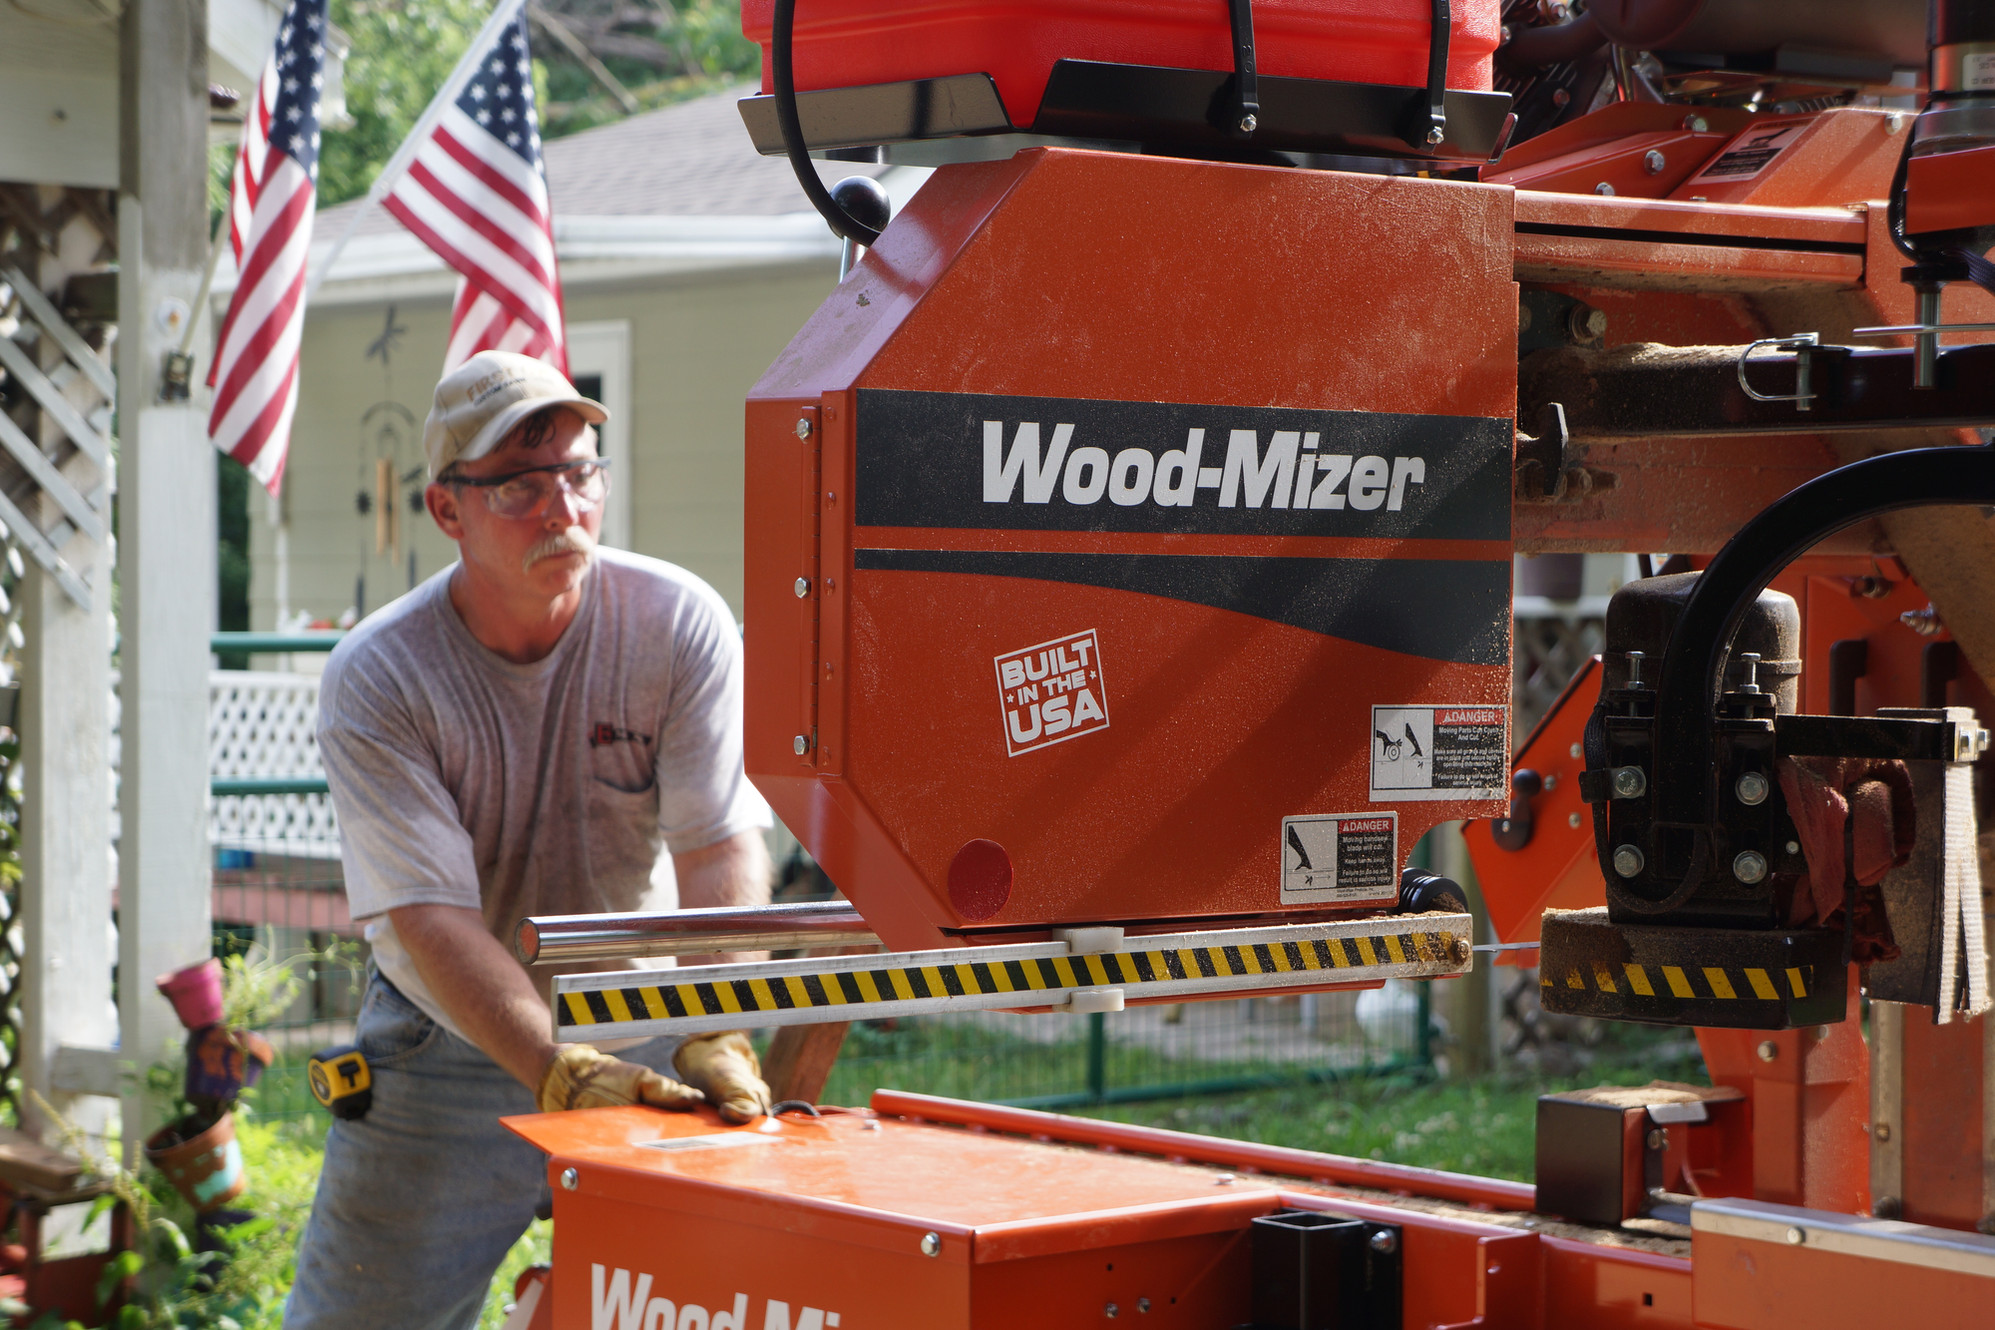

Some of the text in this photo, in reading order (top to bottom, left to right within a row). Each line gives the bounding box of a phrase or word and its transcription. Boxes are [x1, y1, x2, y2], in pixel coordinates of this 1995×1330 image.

[983, 420, 1426, 512] Wood-Mizer
[1001, 638, 1093, 690] BUILT
[1017, 669, 1087, 706] IN THE
[1008, 688, 1105, 744] USA
[1452, 711, 1495, 722] DANGER
[1350, 820, 1390, 831] DANGER
